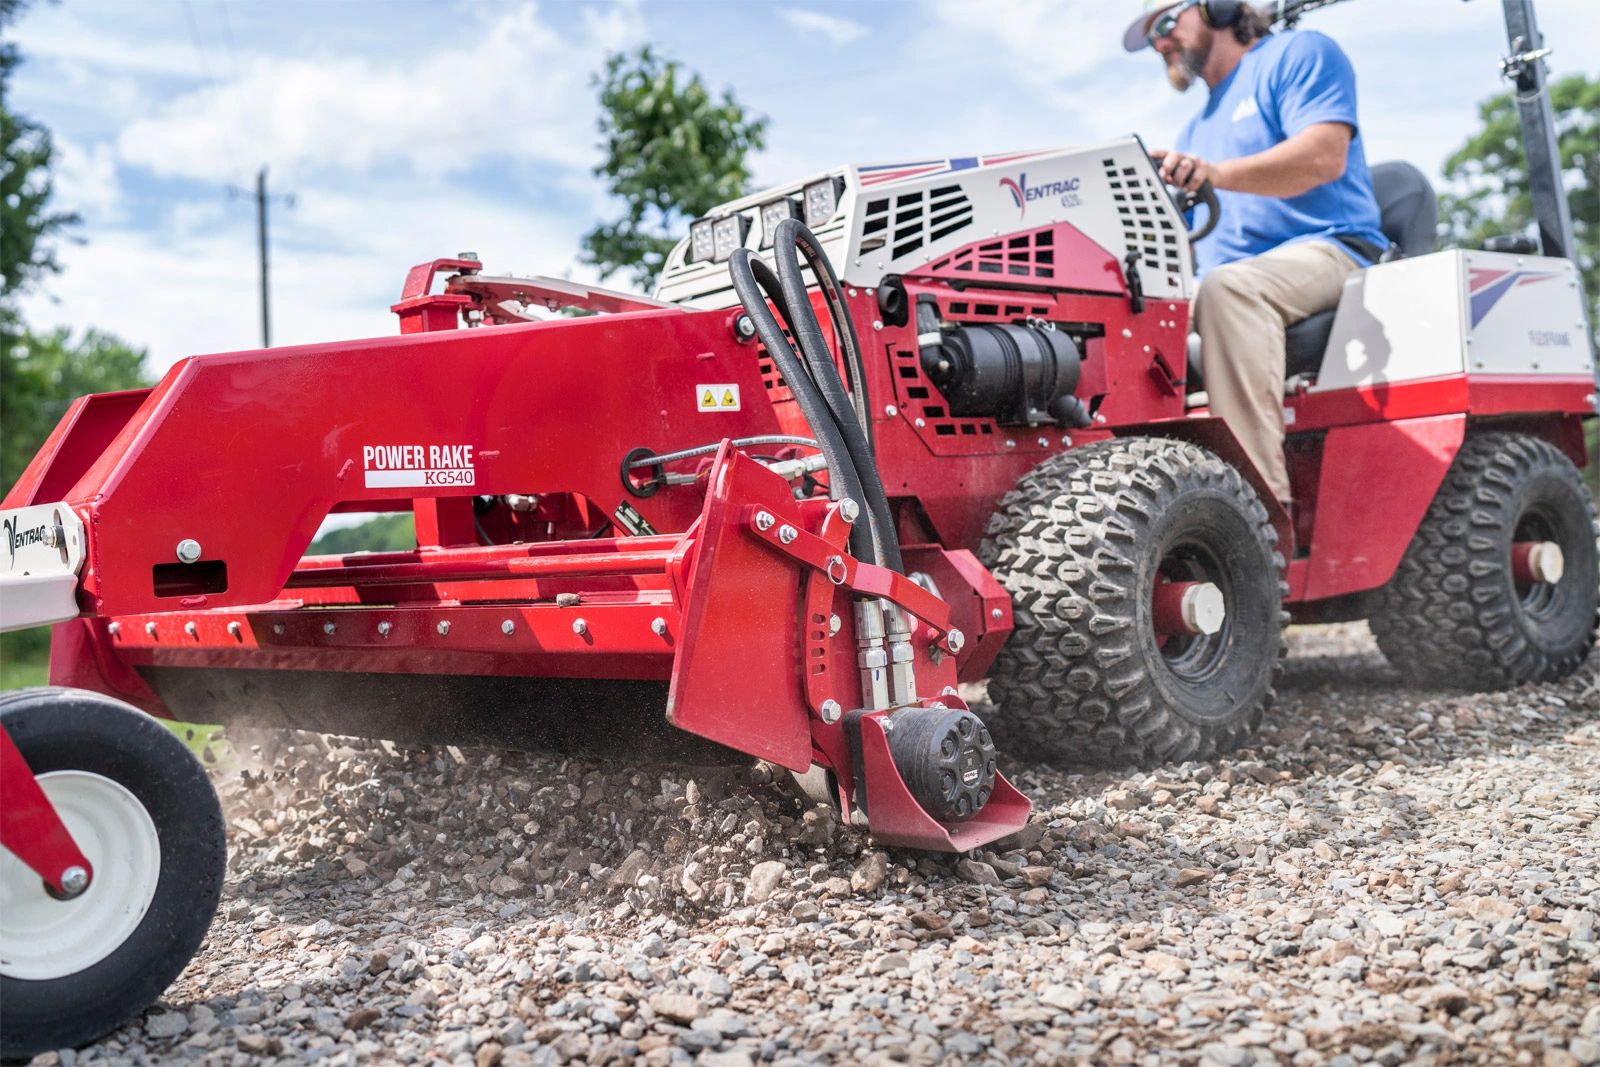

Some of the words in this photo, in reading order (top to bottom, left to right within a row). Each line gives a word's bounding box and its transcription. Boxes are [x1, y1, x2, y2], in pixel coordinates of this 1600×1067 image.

[999, 172, 1080, 221] VENTRAC
[363, 445, 425, 469] POWER
[429, 445, 474, 469] RAKE
[424, 471, 473, 485] KG540
